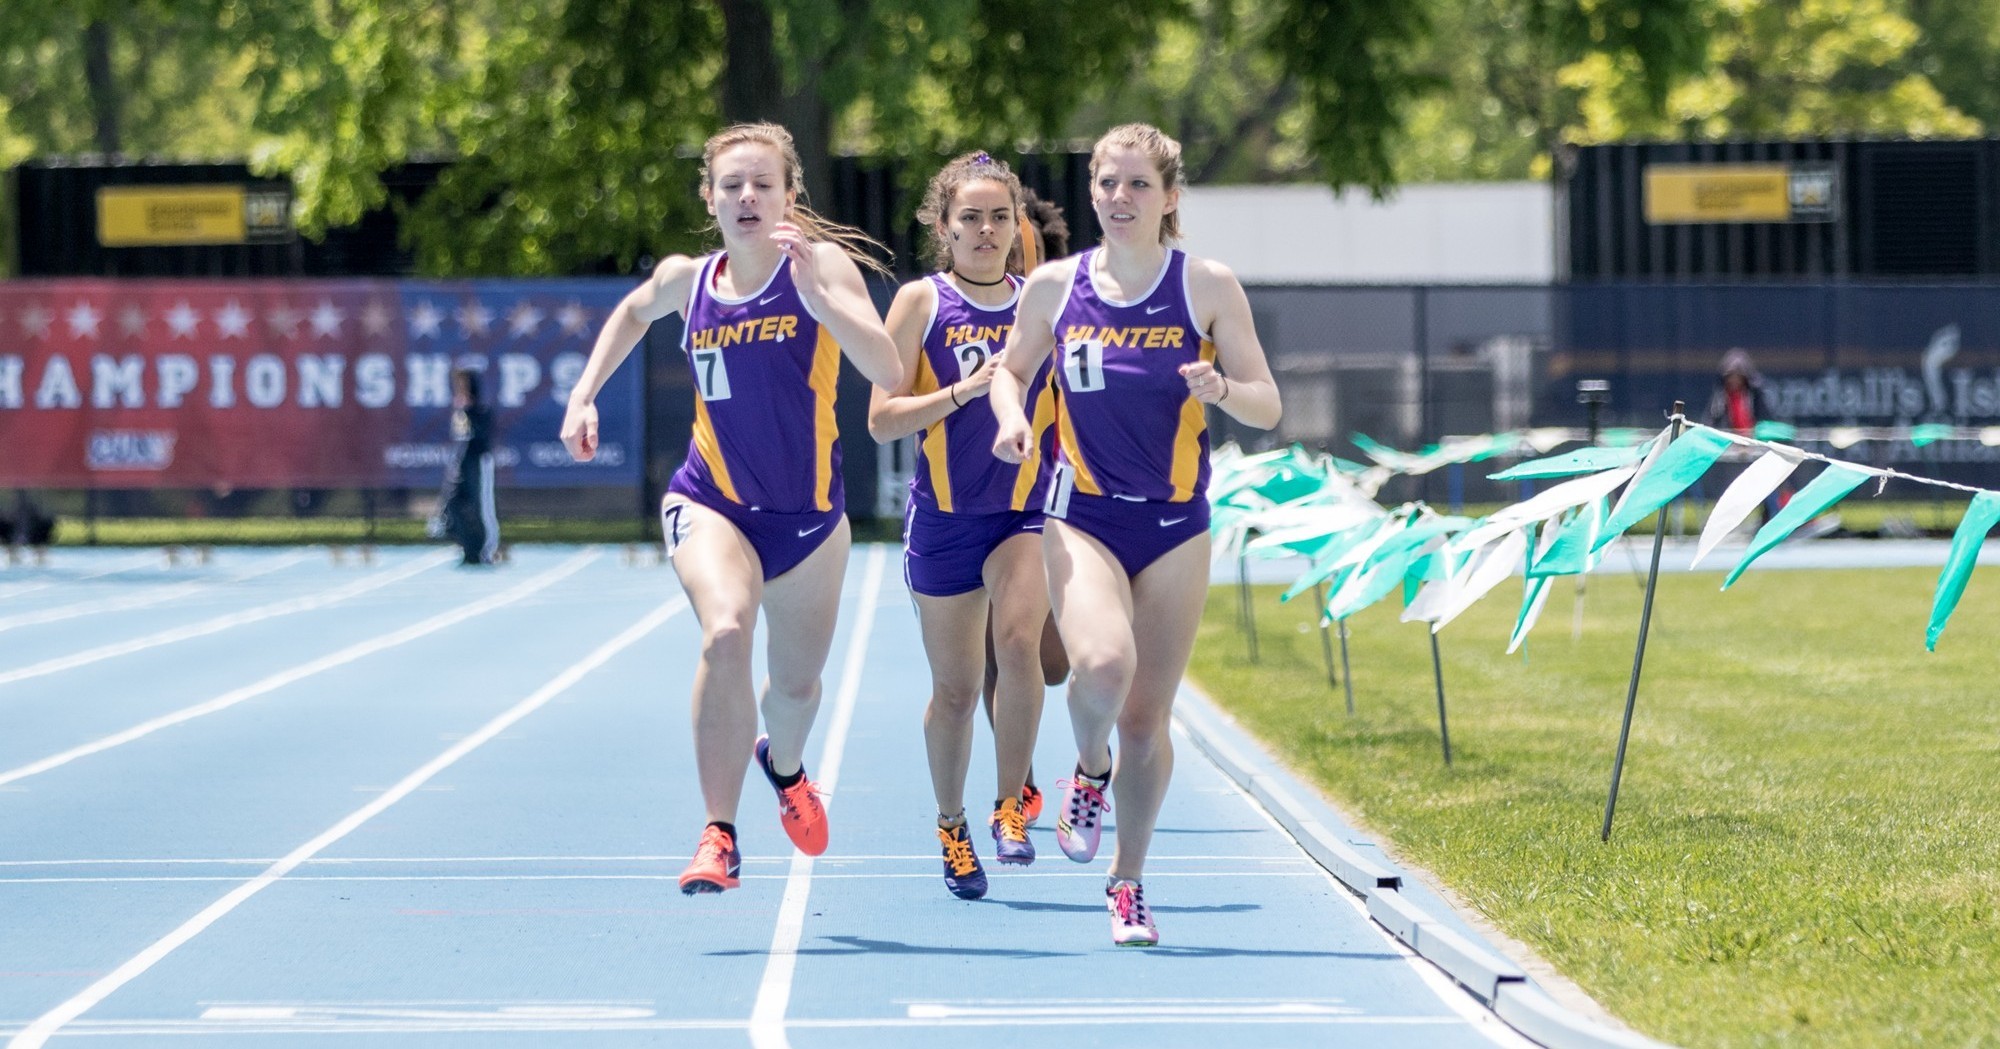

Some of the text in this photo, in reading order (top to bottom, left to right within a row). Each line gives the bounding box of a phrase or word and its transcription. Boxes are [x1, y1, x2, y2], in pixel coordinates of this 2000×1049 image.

[692, 315, 798, 350] HUNTER
[1063, 326, 1185, 348] HUNTER
[696, 352, 717, 397] 7
[961, 346, 986, 378] 2
[1071, 344, 1091, 388] 1
[1051, 468, 1064, 512] 1
[665, 504, 683, 548] 7
